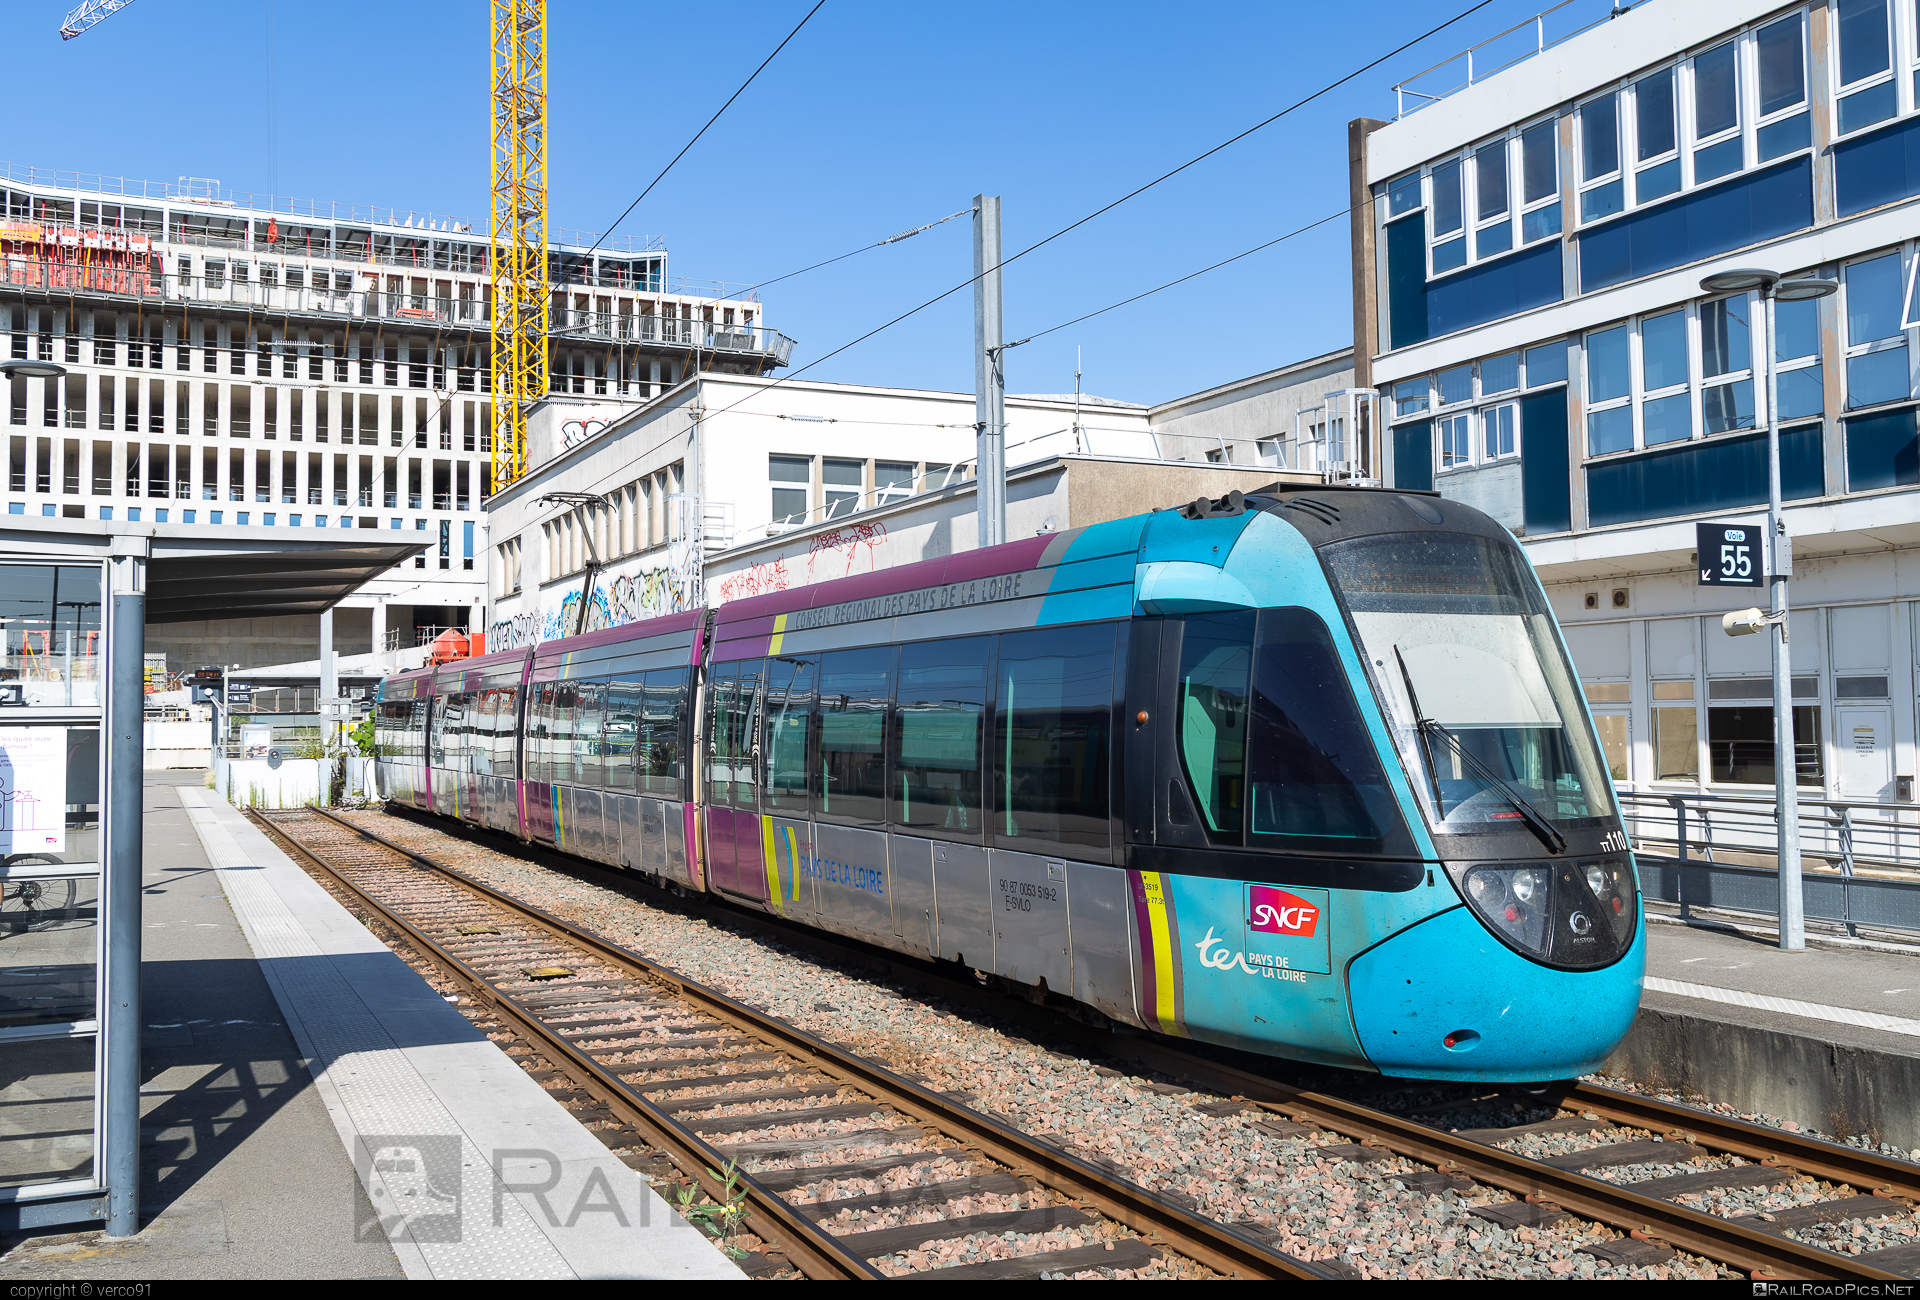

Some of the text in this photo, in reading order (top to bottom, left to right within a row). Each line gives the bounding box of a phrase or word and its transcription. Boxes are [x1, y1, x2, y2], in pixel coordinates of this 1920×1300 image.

[1726, 531, 1743, 541] Voie
[1720, 545, 1752, 576] 55
[795, 608, 830, 629] CONSEIL
[884, 595, 904, 617] DES
[907, 589, 936, 613] PAYS
[941, 585, 956, 607] DE
[961, 582, 975, 605] LA
[982, 574, 1022, 601] LOIRE
[801, 856, 884, 894] PAYS DE LA LOIRE
[1000, 879, 1057, 902] 90 87 0053 519-2
[1005, 895, 1032, 912] F-SVLO
[1253, 904, 1316, 930] SNCF
[1195, 926, 1260, 975] ter
[1248, 952, 1289, 969] PAYS DE
[1261, 967, 1307, 983] LA LOIRE
